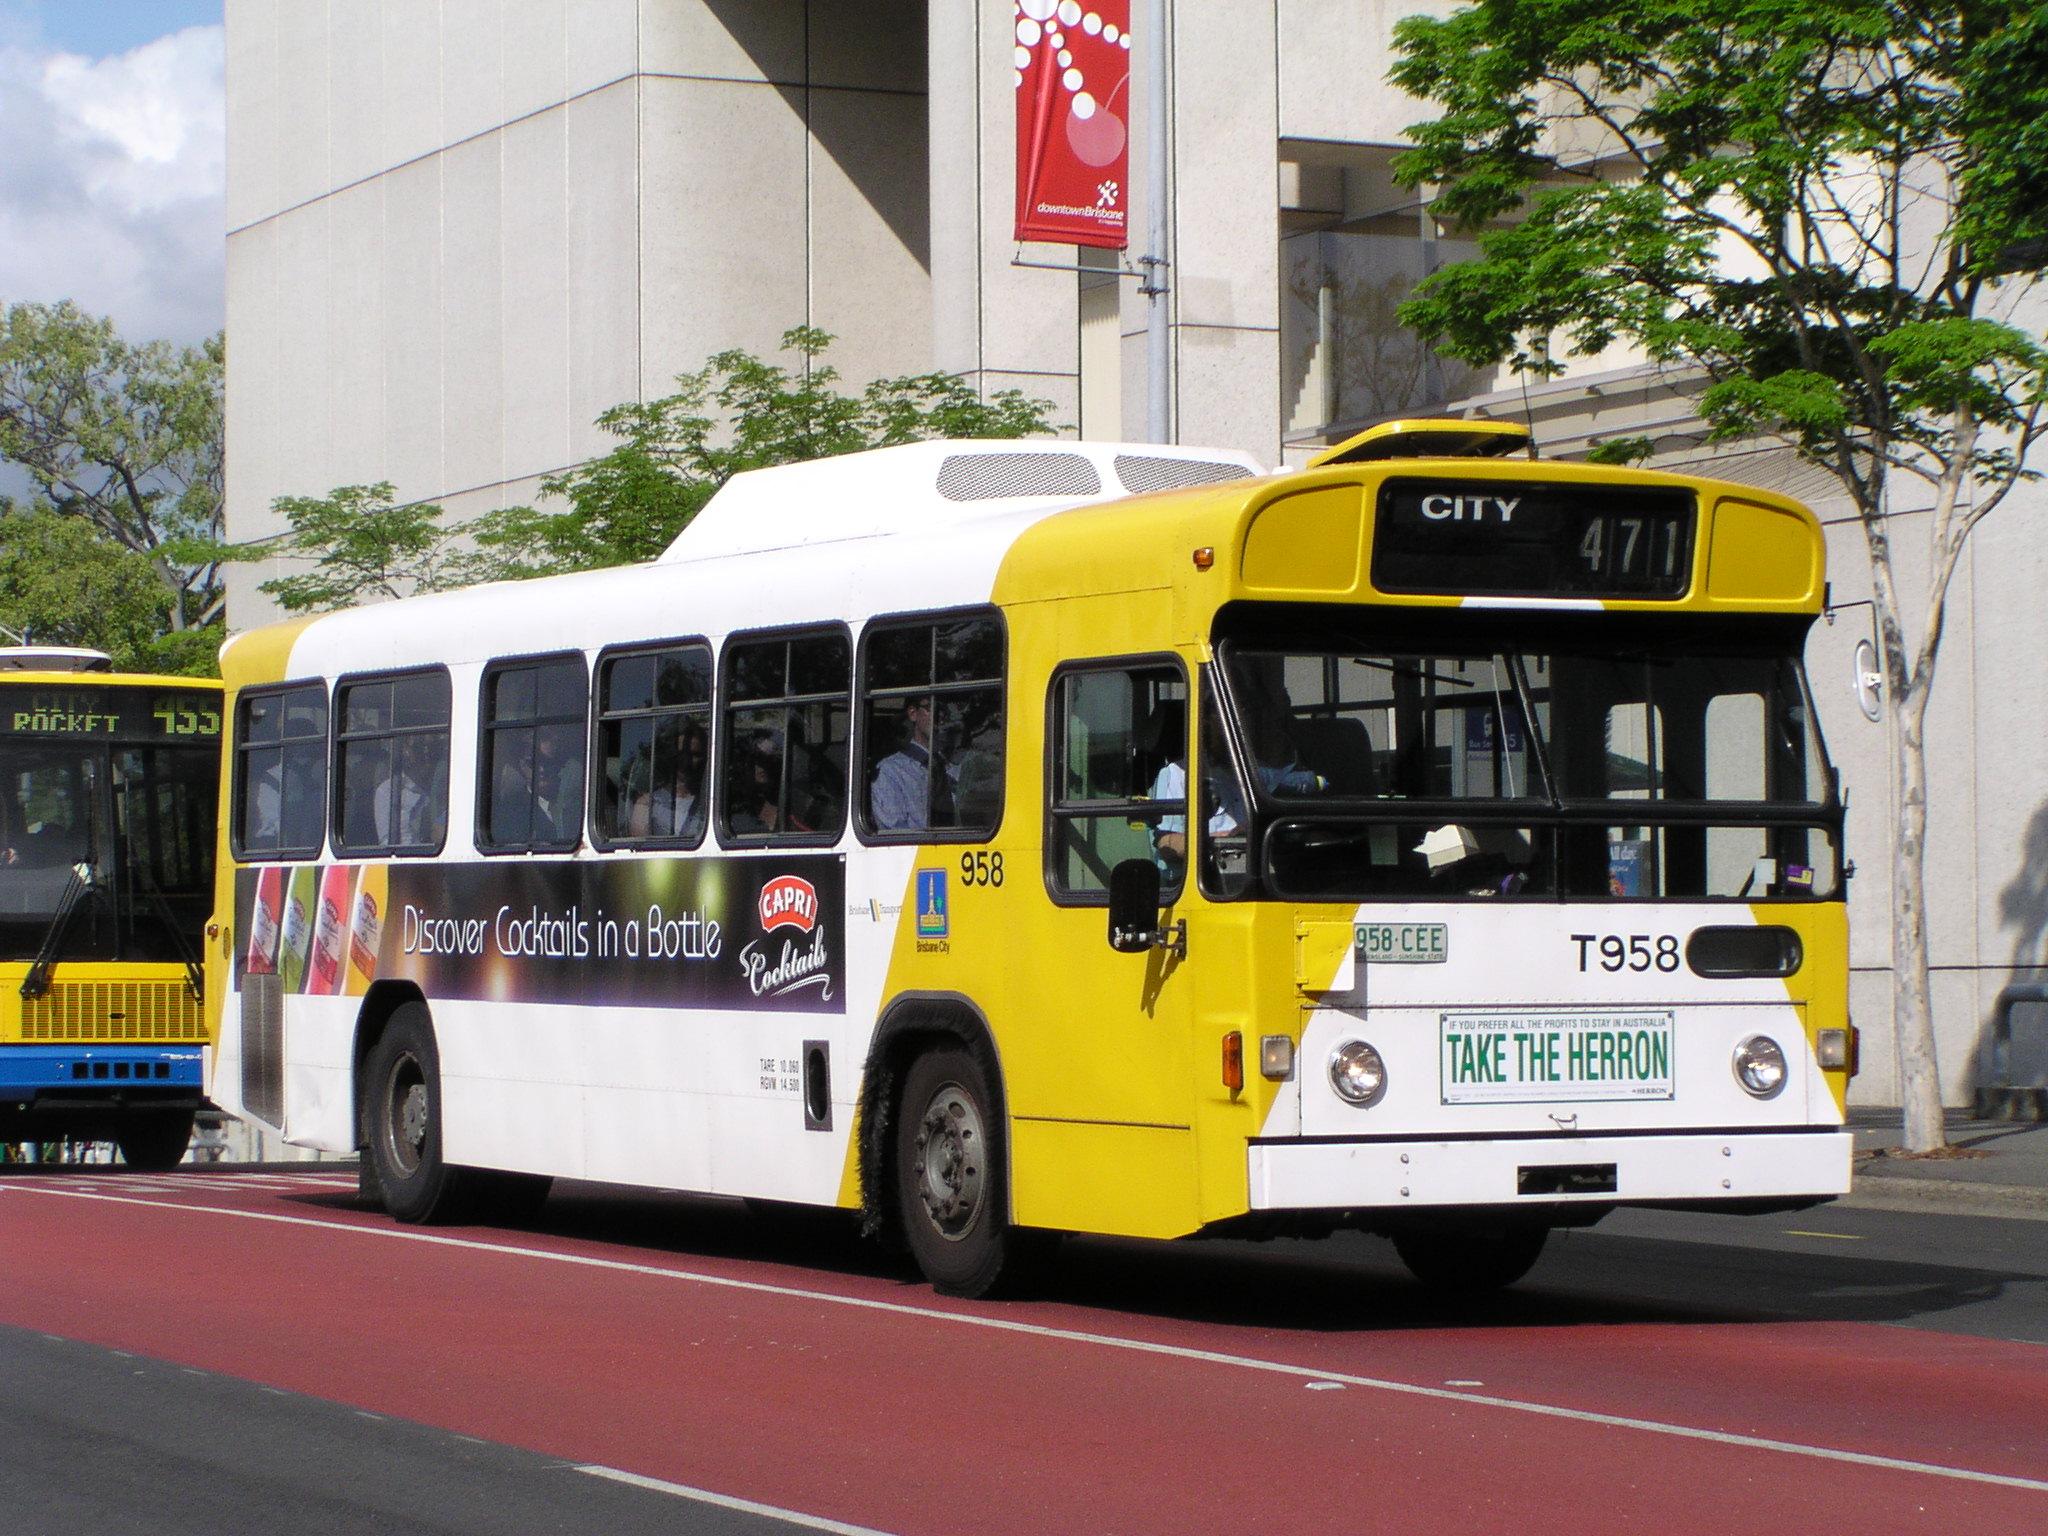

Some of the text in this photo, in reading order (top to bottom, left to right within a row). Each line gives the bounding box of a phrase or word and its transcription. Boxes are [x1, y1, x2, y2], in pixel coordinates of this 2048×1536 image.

[1421, 494, 1521, 522] CITY
[1578, 517, 1677, 576] 471
[961, 850, 1004, 887] 958
[762, 886, 812, 920] CAPRI
[404, 904, 722, 958] Discover Cocktails in a Bottle
[740, 925, 828, 997] Cocktails
[1570, 934, 1680, 973] T958
[1449, 1018, 1666, 1030] IF YOU PREFER ALL THE PROFITS TO STAY IN AUSTRALIA
[1446, 1030, 1668, 1083] TAKE THE HERRON
